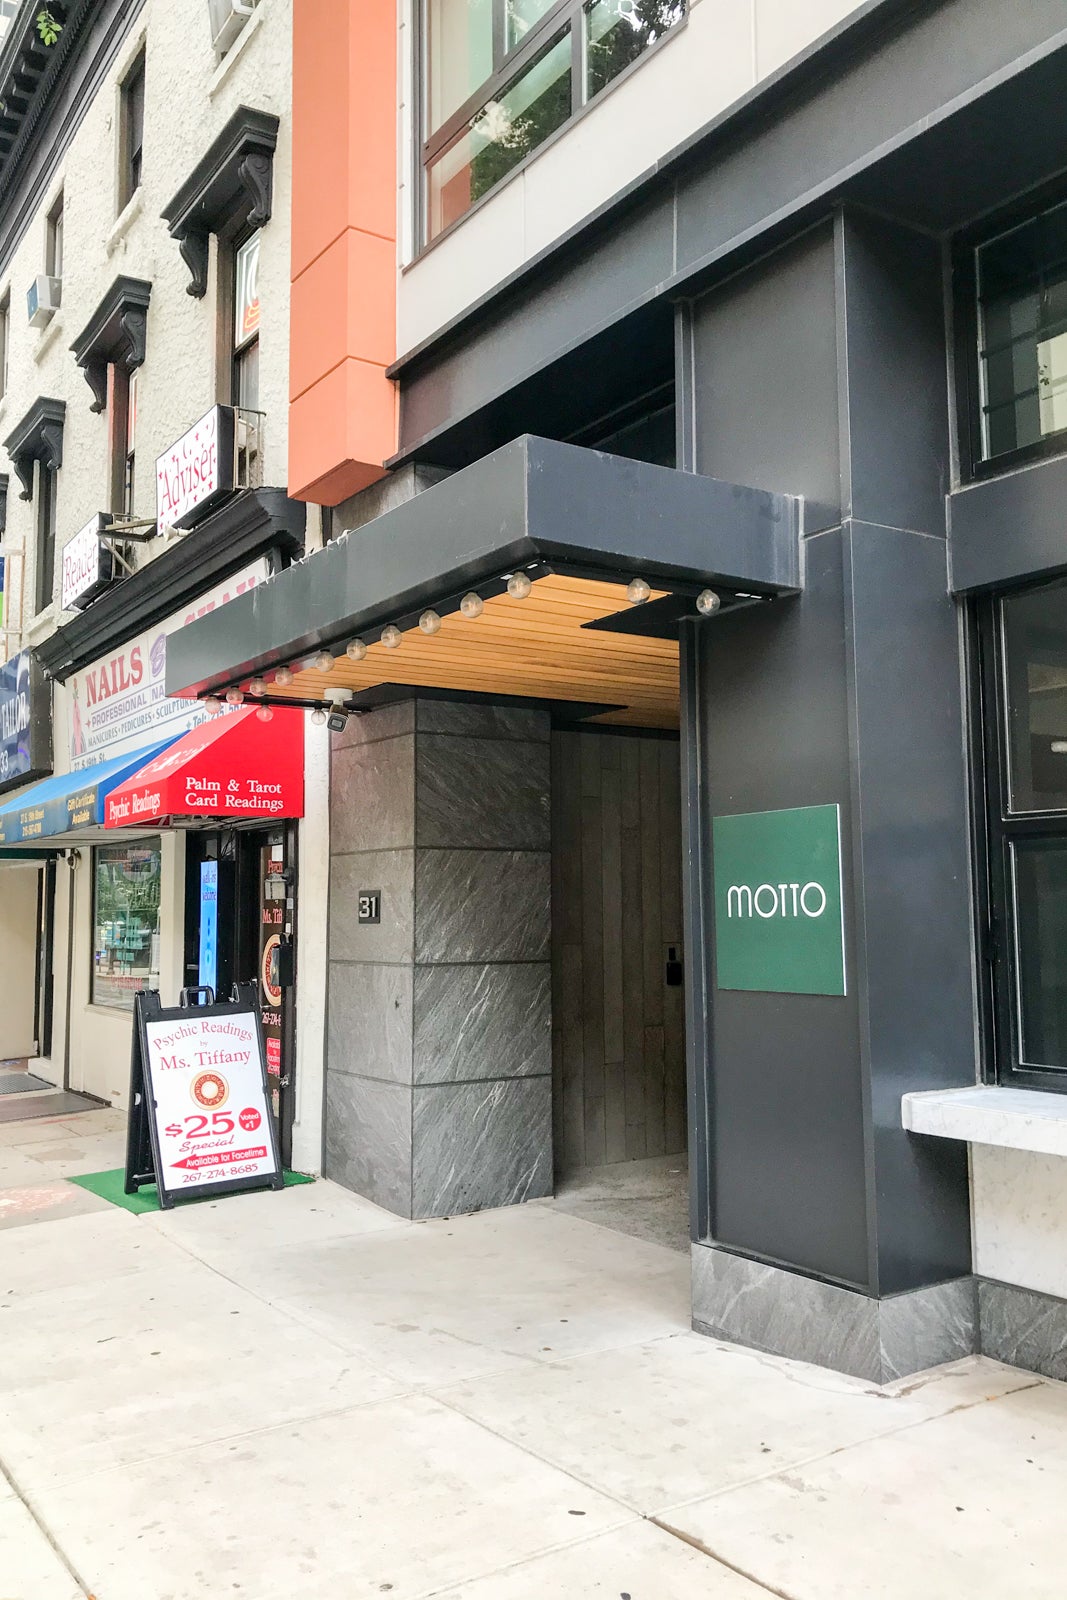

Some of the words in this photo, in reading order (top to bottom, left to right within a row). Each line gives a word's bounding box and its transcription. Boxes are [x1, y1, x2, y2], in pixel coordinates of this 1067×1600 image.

[160, 443, 215, 515] Adviser
[64, 543, 97, 592] Reader
[85, 646, 143, 708] NAILS
[2, 691, 27, 740] TAILOR
[91, 693, 147, 728] PROFESSIONAL
[88, 726, 118, 748] MANICURES
[121, 712, 152, 733] PEDICURES
[185, 777, 221, 791] Palm
[227, 779, 240, 791] &
[246, 779, 282, 794] Tarot
[109, 797, 131, 824] Psychic
[131, 789, 160, 815] Readings
[185, 793, 218, 807] Card
[225, 796, 284, 811] Readings
[359, 896, 376, 918] 31
[727, 881, 827, 919] MOTTO
[153, 1024, 198, 1050] Psychic
[202, 1021, 254, 1042] Readings
[199, 1040, 209, 1048] by
[160, 1056, 191, 1071] Ms.
[194, 1049, 251, 1066] Tiffany
[164, 1111, 235, 1139] $25
[240, 1112, 260, 1121] Voted
[245, 1120, 255, 1129] #1
[179, 1134, 235, 1154] Special
[186, 1153, 219, 1168] Available
[220, 1152, 231, 1163] for
[231, 1148, 264, 1160] Facetime
[182, 1163, 259, 1184] 267-274-8685
